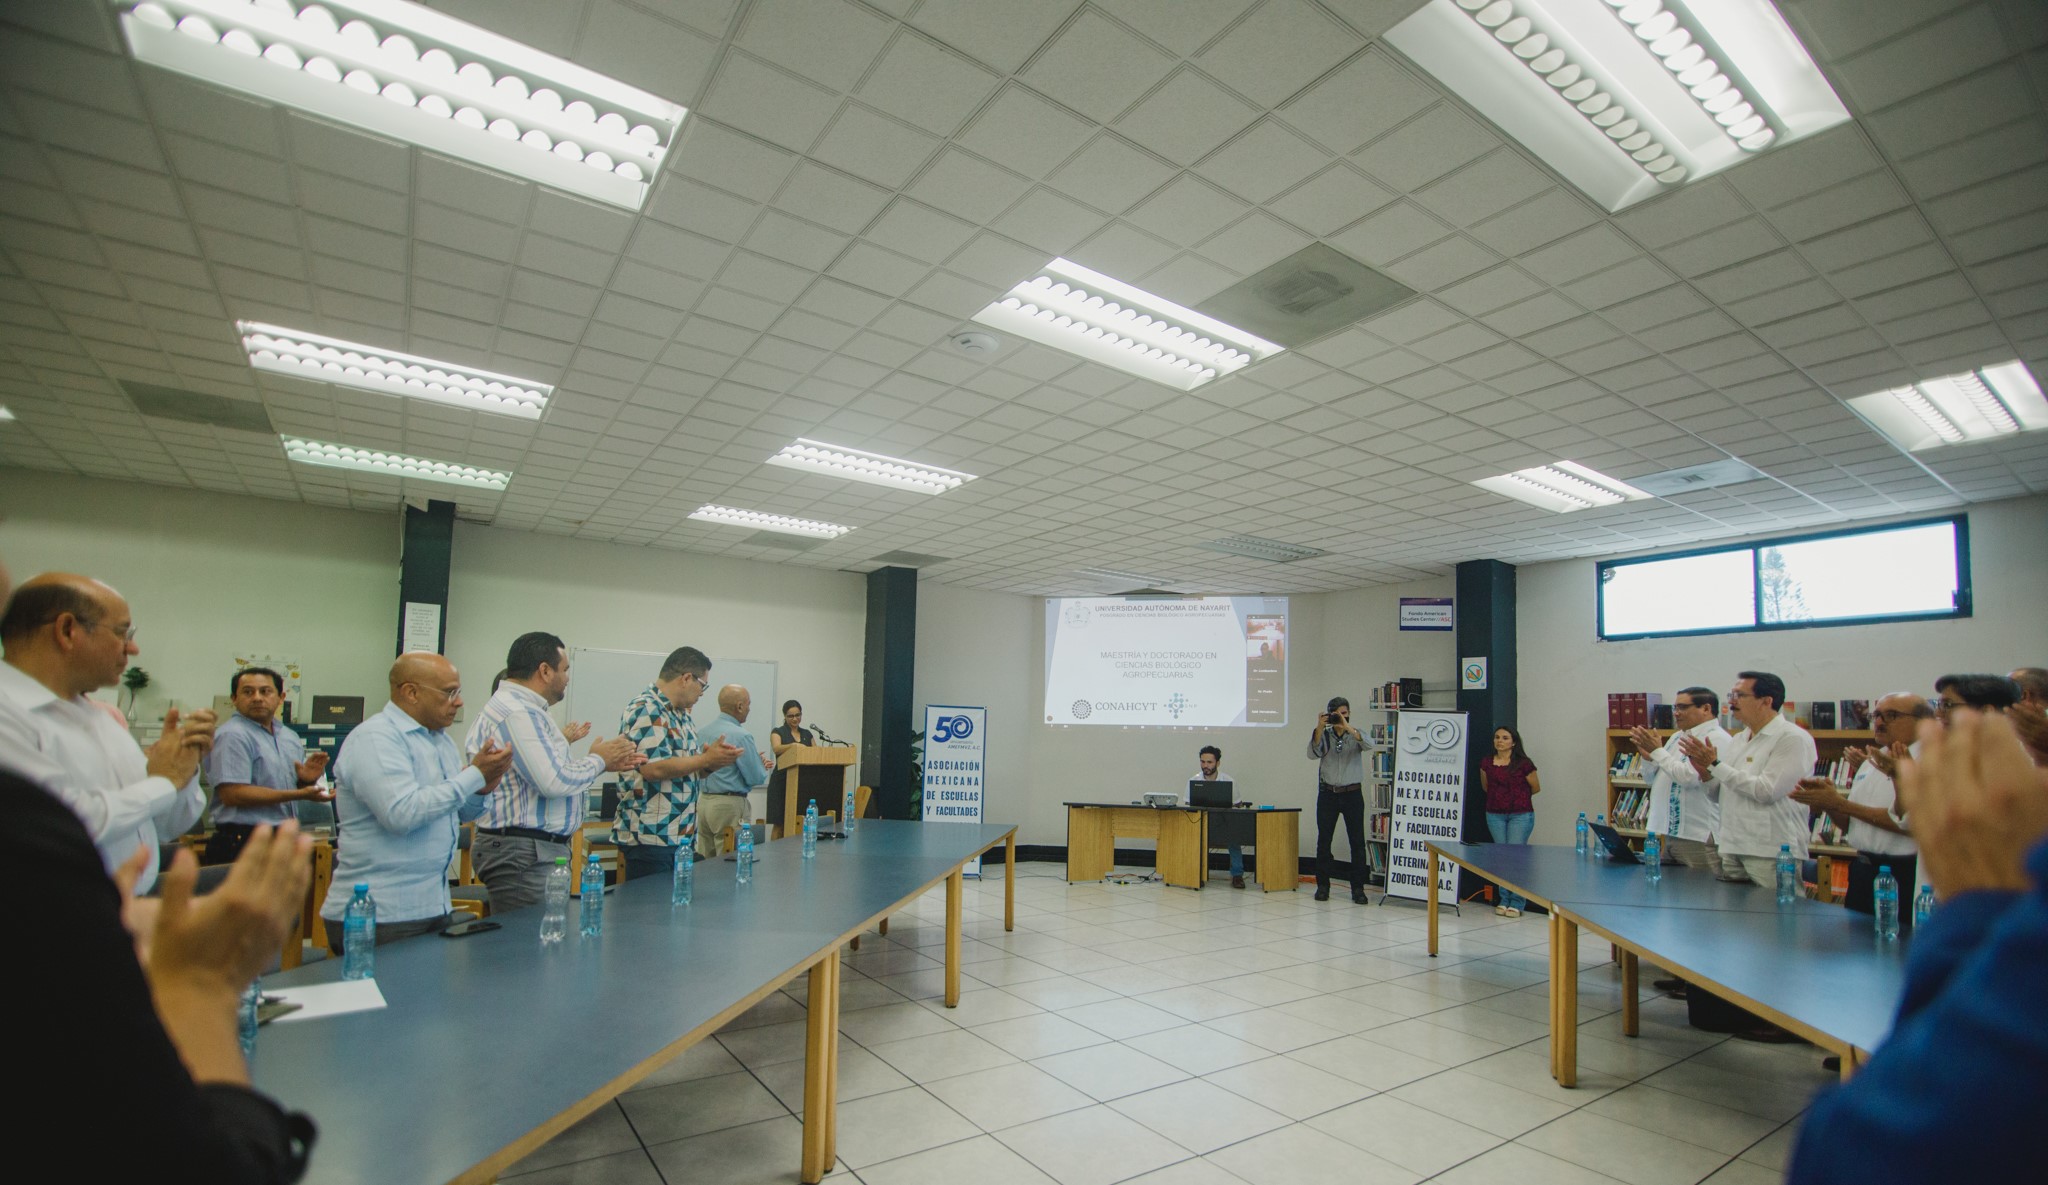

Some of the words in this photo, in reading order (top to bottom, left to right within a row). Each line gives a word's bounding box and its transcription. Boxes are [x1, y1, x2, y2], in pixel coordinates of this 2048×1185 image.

[1100, 651, 1142, 659] MAESTRÍA
[1115, 661, 1153, 669] CIENCIAS
[1155, 661, 1202, 669] BIOLÓGICO
[1095, 702, 1158, 711] CONAHCYT
[931, 714, 974, 743] 50
[1402, 718, 1461, 754] 50
[927, 760, 980, 771] ASOCIACIÓN
[926, 775, 979, 786] MEXICANA
[1397, 770, 1460, 786] ASOCIACIÓN
[926, 790, 936, 800] DE
[940, 791, 979, 802] ESCUELAS
[1396, 787, 1459, 803] MEXICANA
[926, 805, 931, 815] Y
[936, 806, 978, 817] FACULTADES
[1395, 804, 1407, 816] DE
[1412, 805, 1458, 821] ESCUELAS
[1395, 821, 1401, 832] Y
[1406, 821, 1457, 838] FACULTADES
[1393, 838, 1404, 849] DE
[1448, 862, 1455, 873] Y
[1391, 872, 1429, 887] ZOOTECNI
[1438, 879, 1453, 891] A.C.
